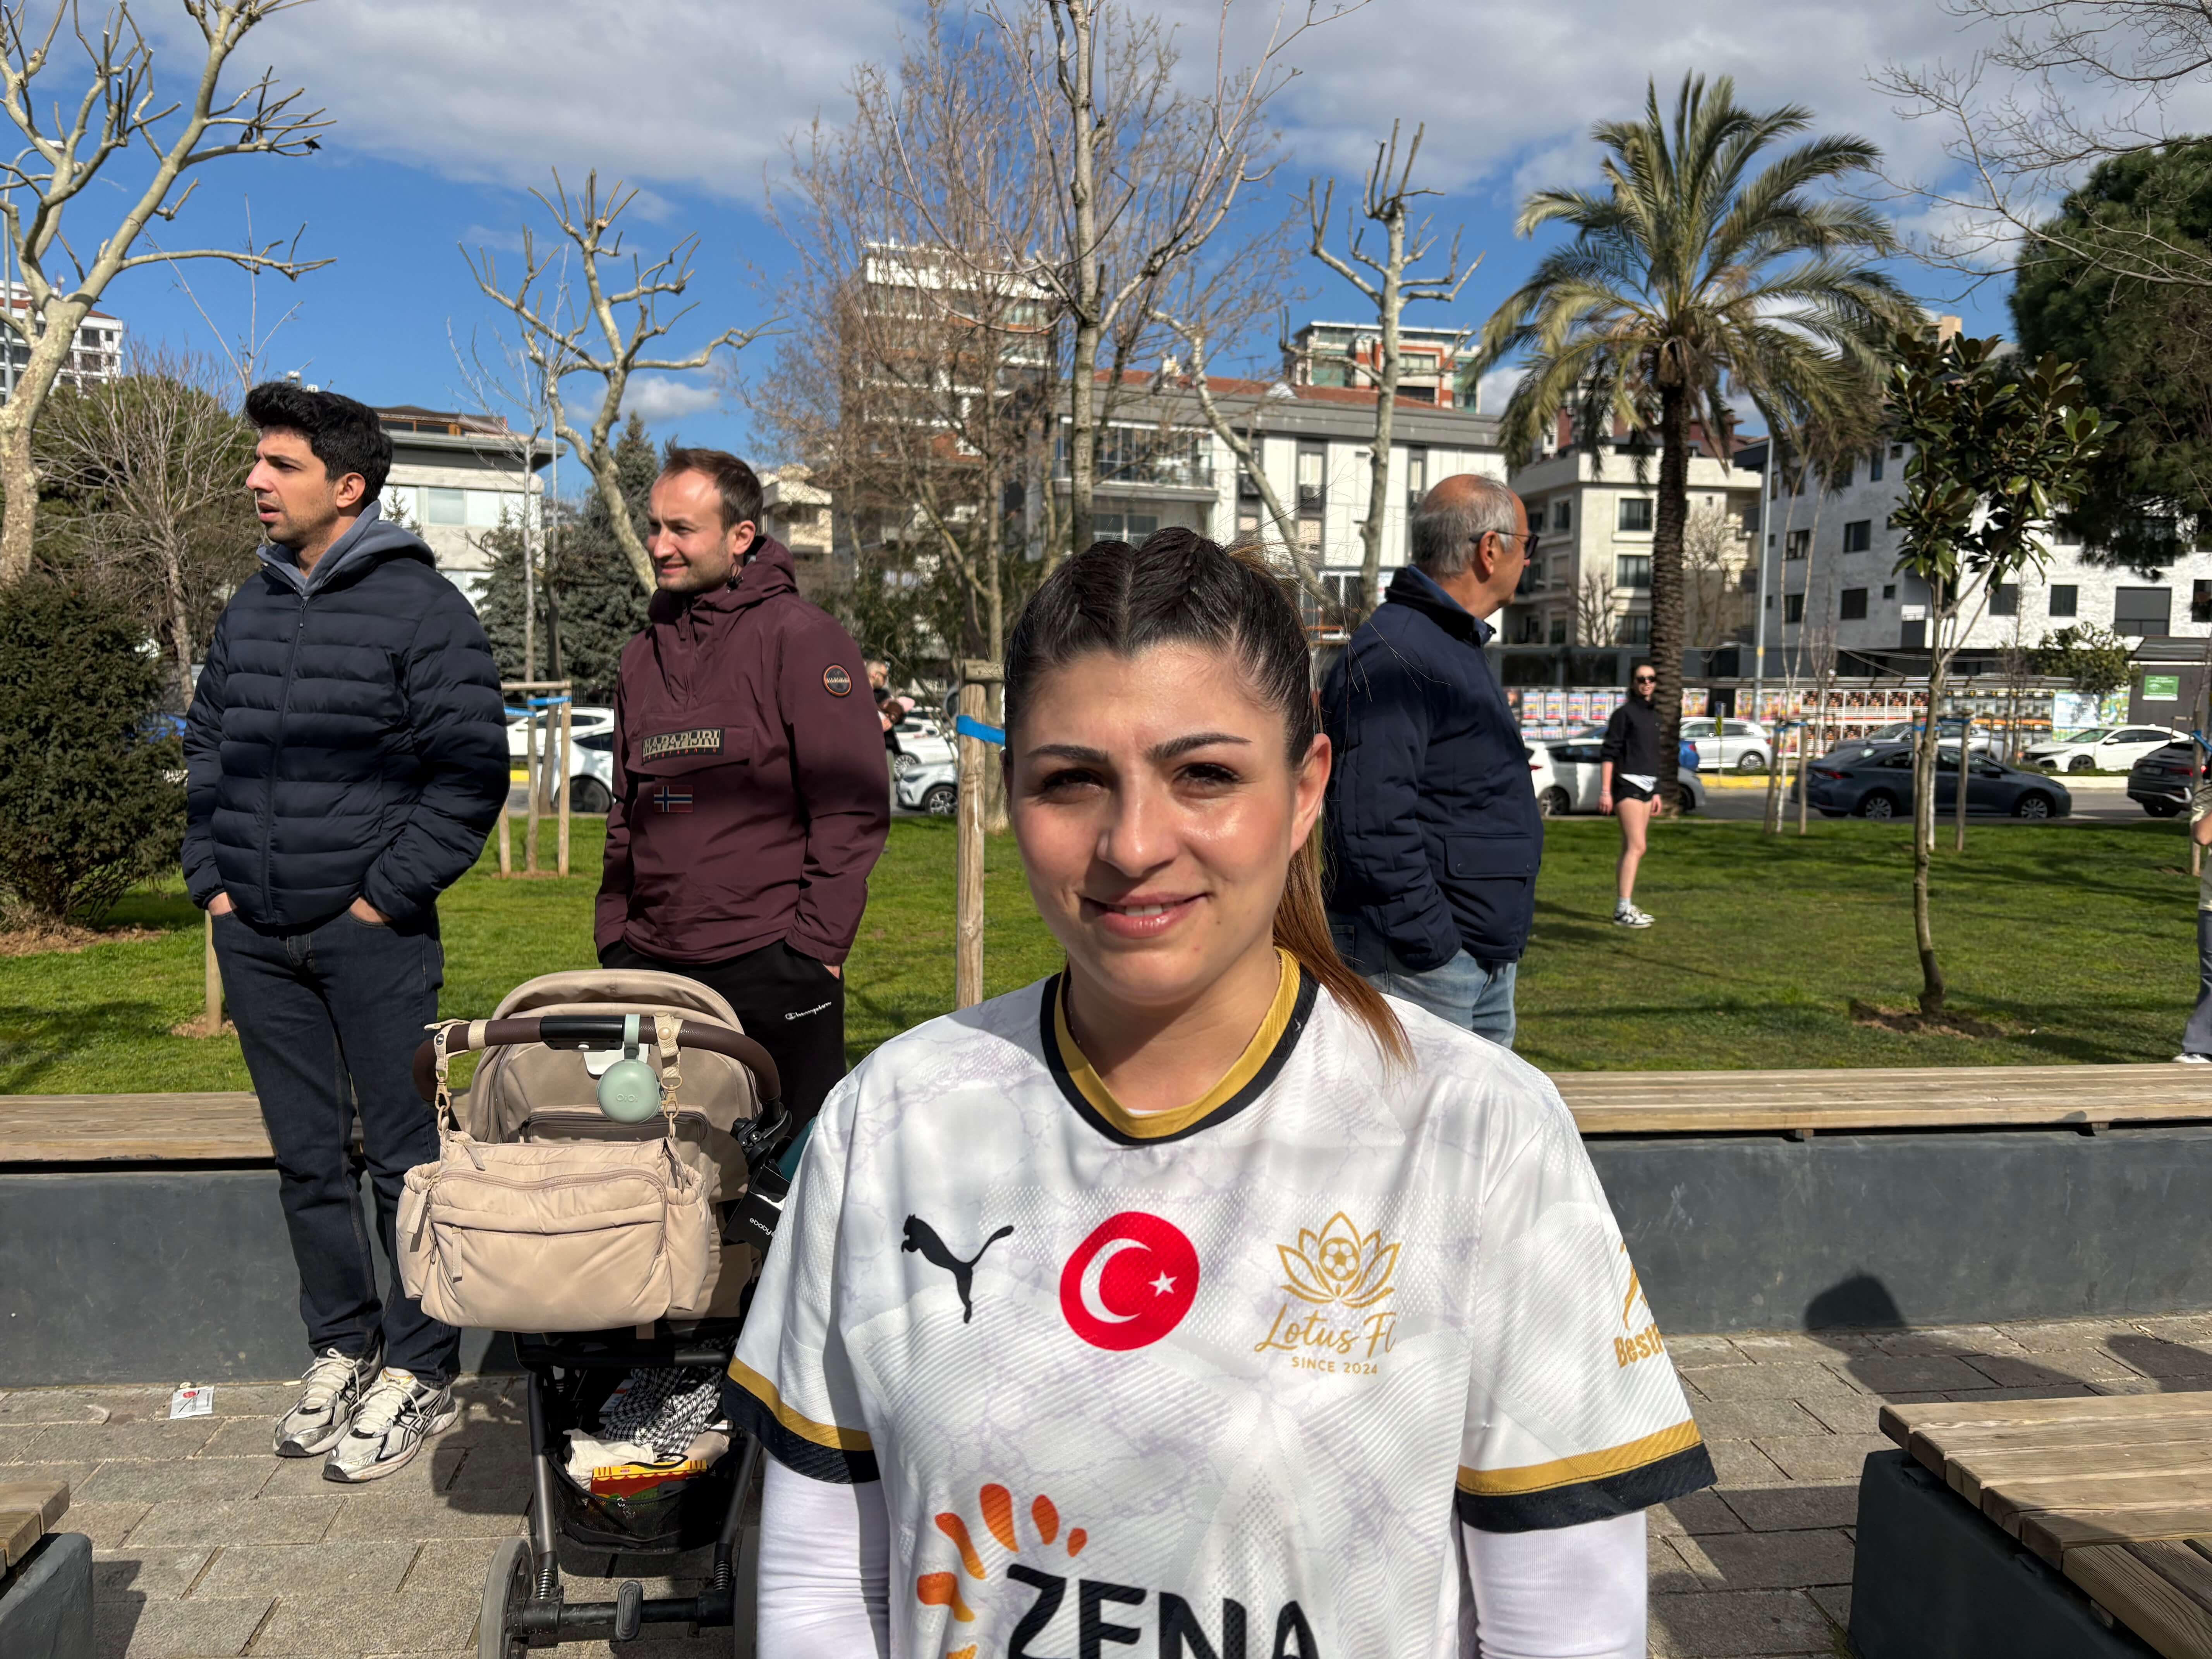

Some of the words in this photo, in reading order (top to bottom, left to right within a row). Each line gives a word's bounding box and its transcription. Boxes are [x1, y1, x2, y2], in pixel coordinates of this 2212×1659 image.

[644, 729, 720, 756] NAPAPIJRI
[1254, 1302, 1359, 1354] Lotus
[1291, 1357, 1335, 1373] SINCE
[1343, 1362, 1378, 1374] 2024
